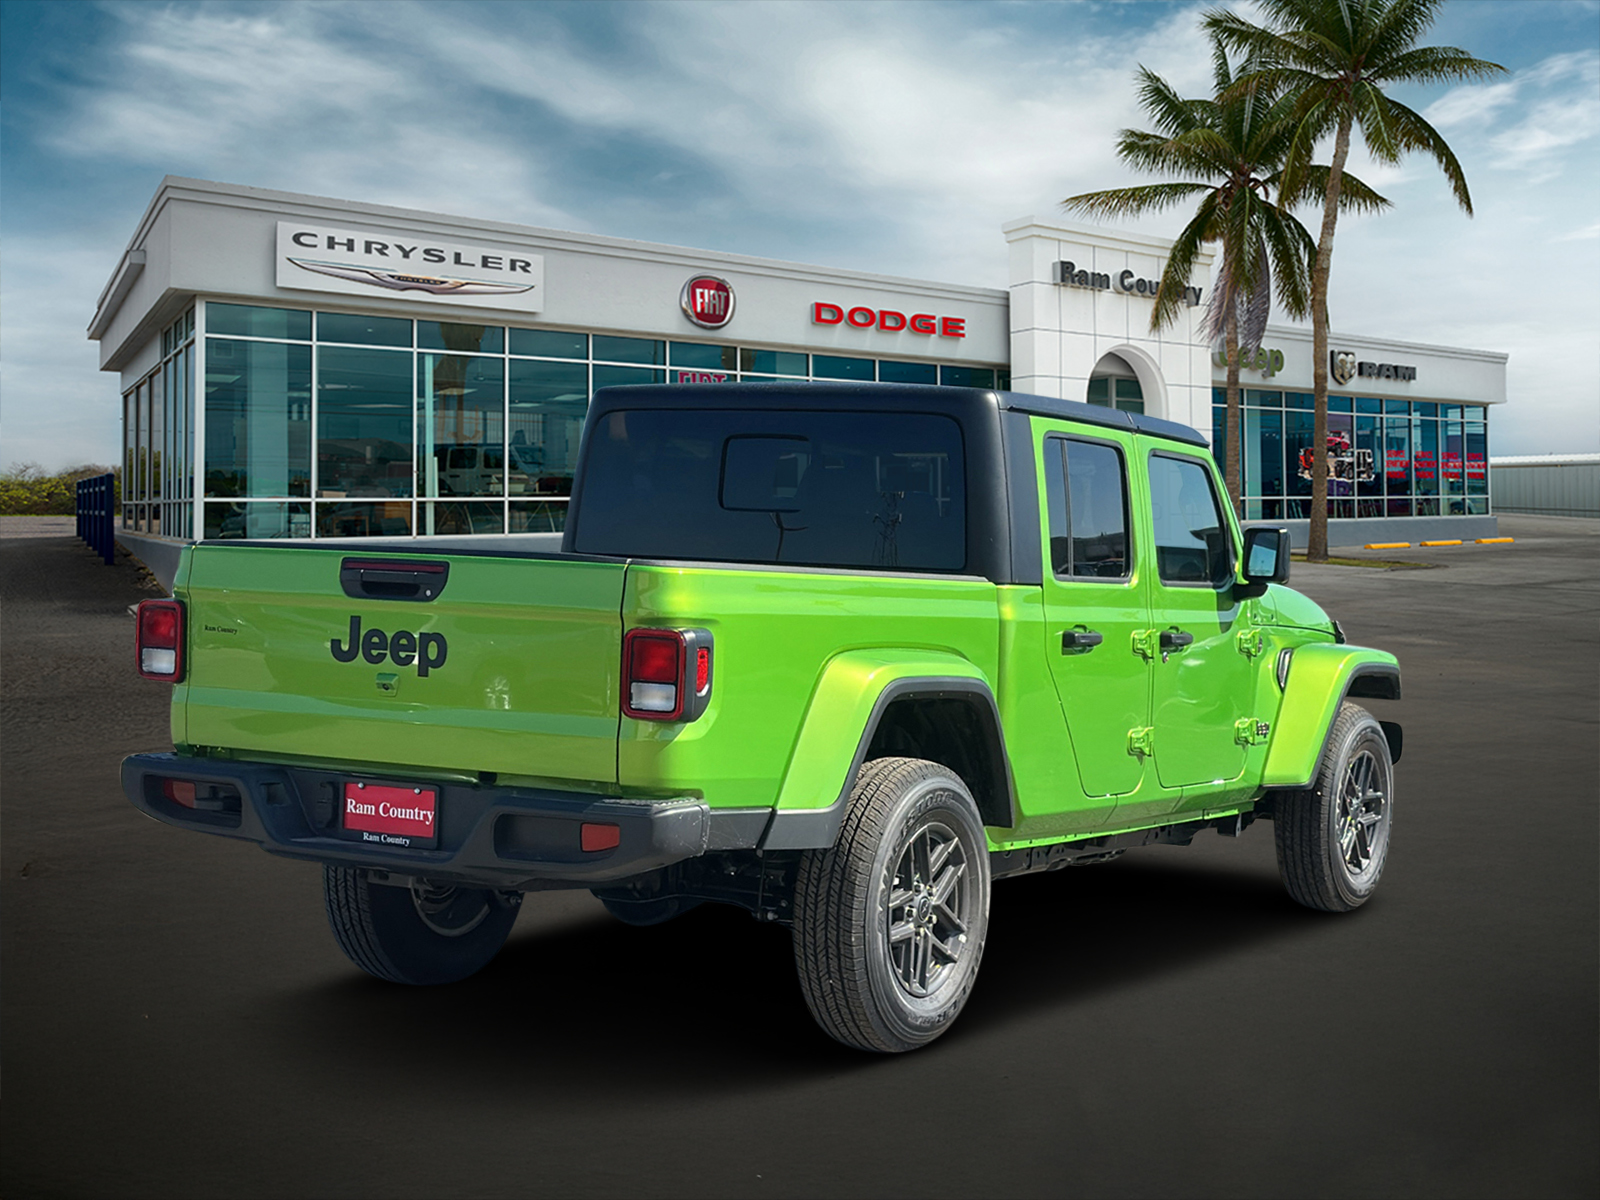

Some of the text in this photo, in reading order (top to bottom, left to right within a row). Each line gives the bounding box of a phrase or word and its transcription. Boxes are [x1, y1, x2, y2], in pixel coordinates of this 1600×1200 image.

[291, 231, 533, 274] CHRYSLER
[1052, 260, 1111, 291] Ram
[695, 287, 728, 316] FIAT
[812, 301, 966, 338] DODGE
[1357, 361, 1416, 380] RAM
[330, 615, 447, 677] Jeep
[346, 798, 435, 825] Ram Country
[363, 832, 411, 847] Ram Country
